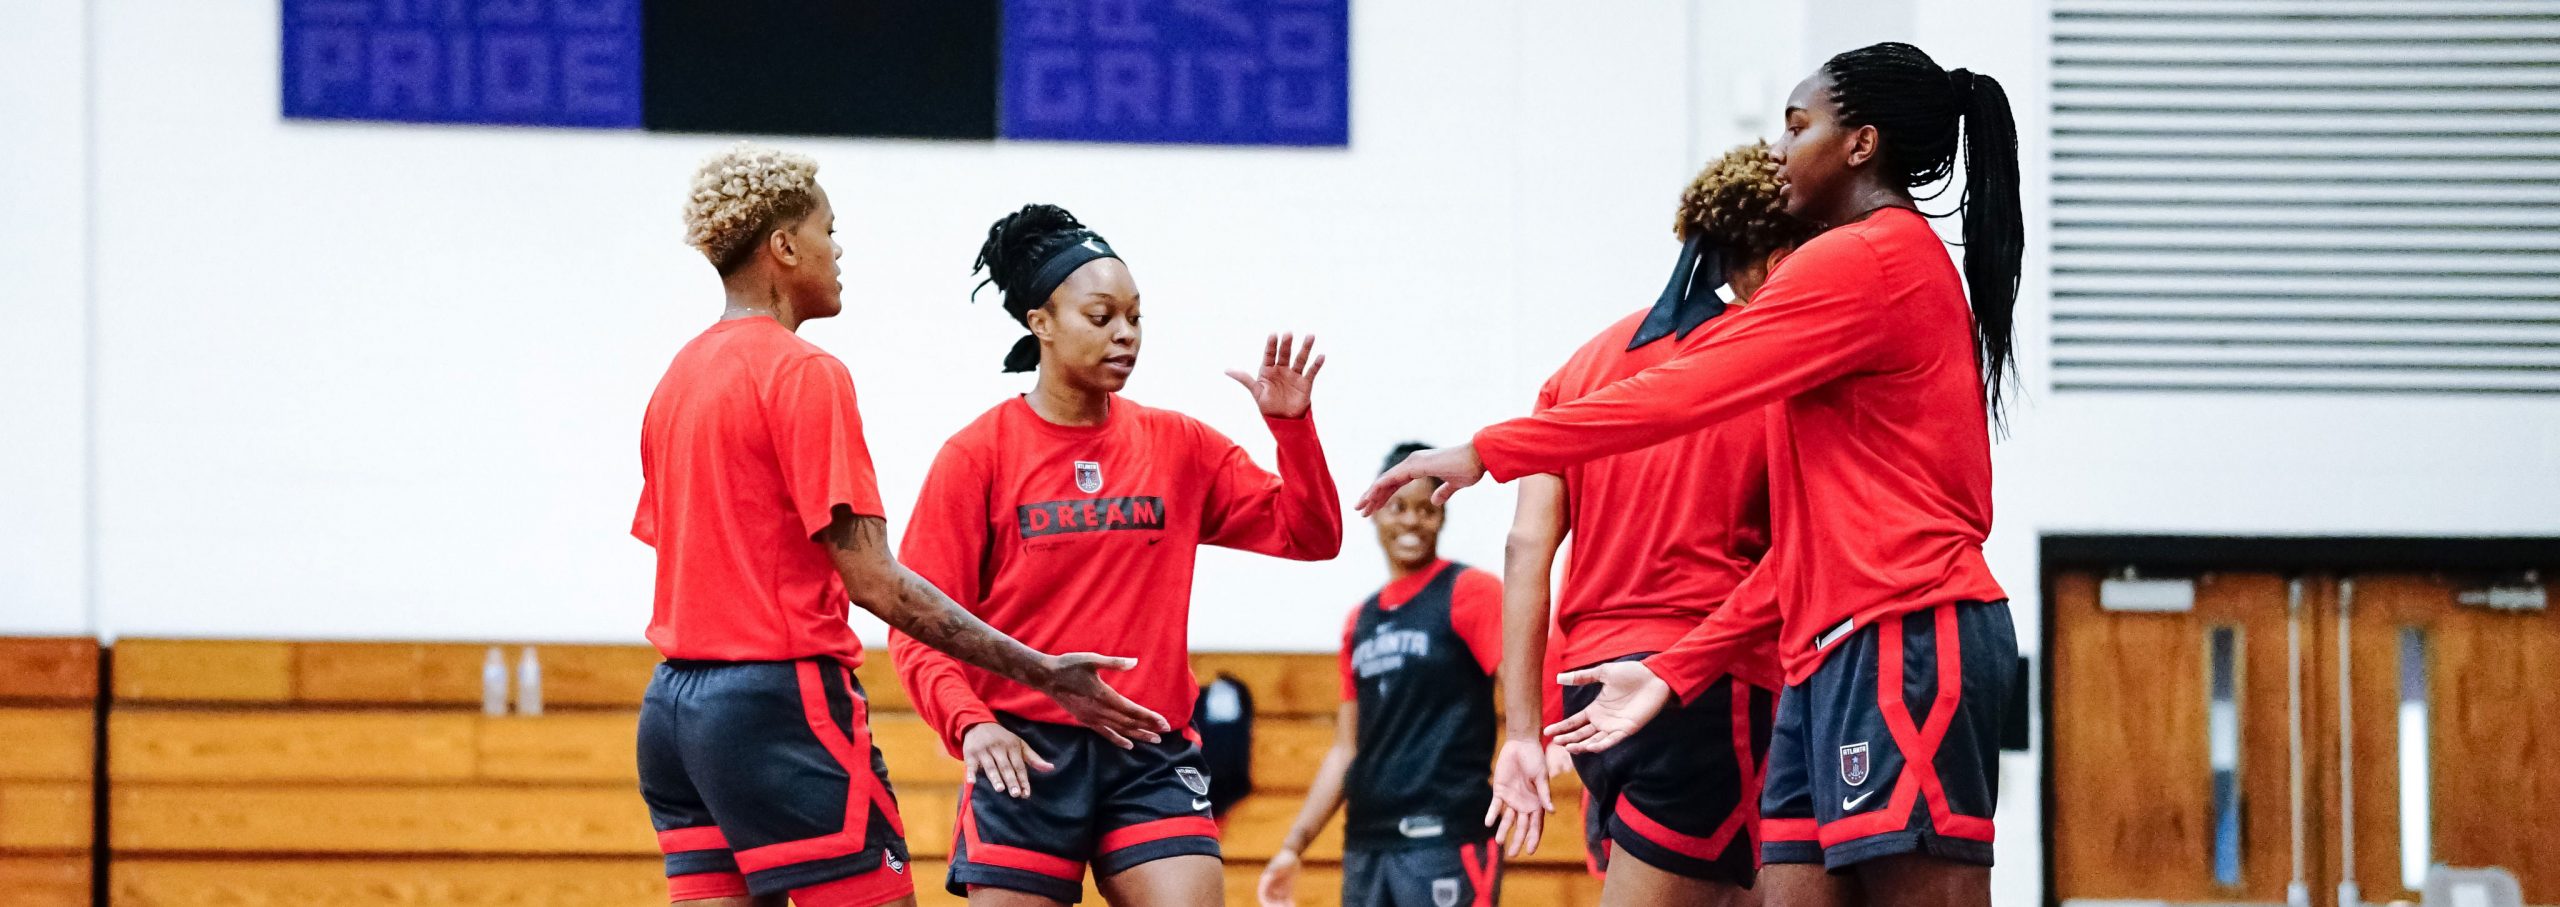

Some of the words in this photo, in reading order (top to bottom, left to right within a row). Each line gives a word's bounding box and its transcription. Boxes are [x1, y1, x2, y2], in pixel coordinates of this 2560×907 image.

[300, 28, 622, 111] PRIDE
[1023, 49, 1258, 125] GRIT
[1028, 501, 1157, 532] DREAM
